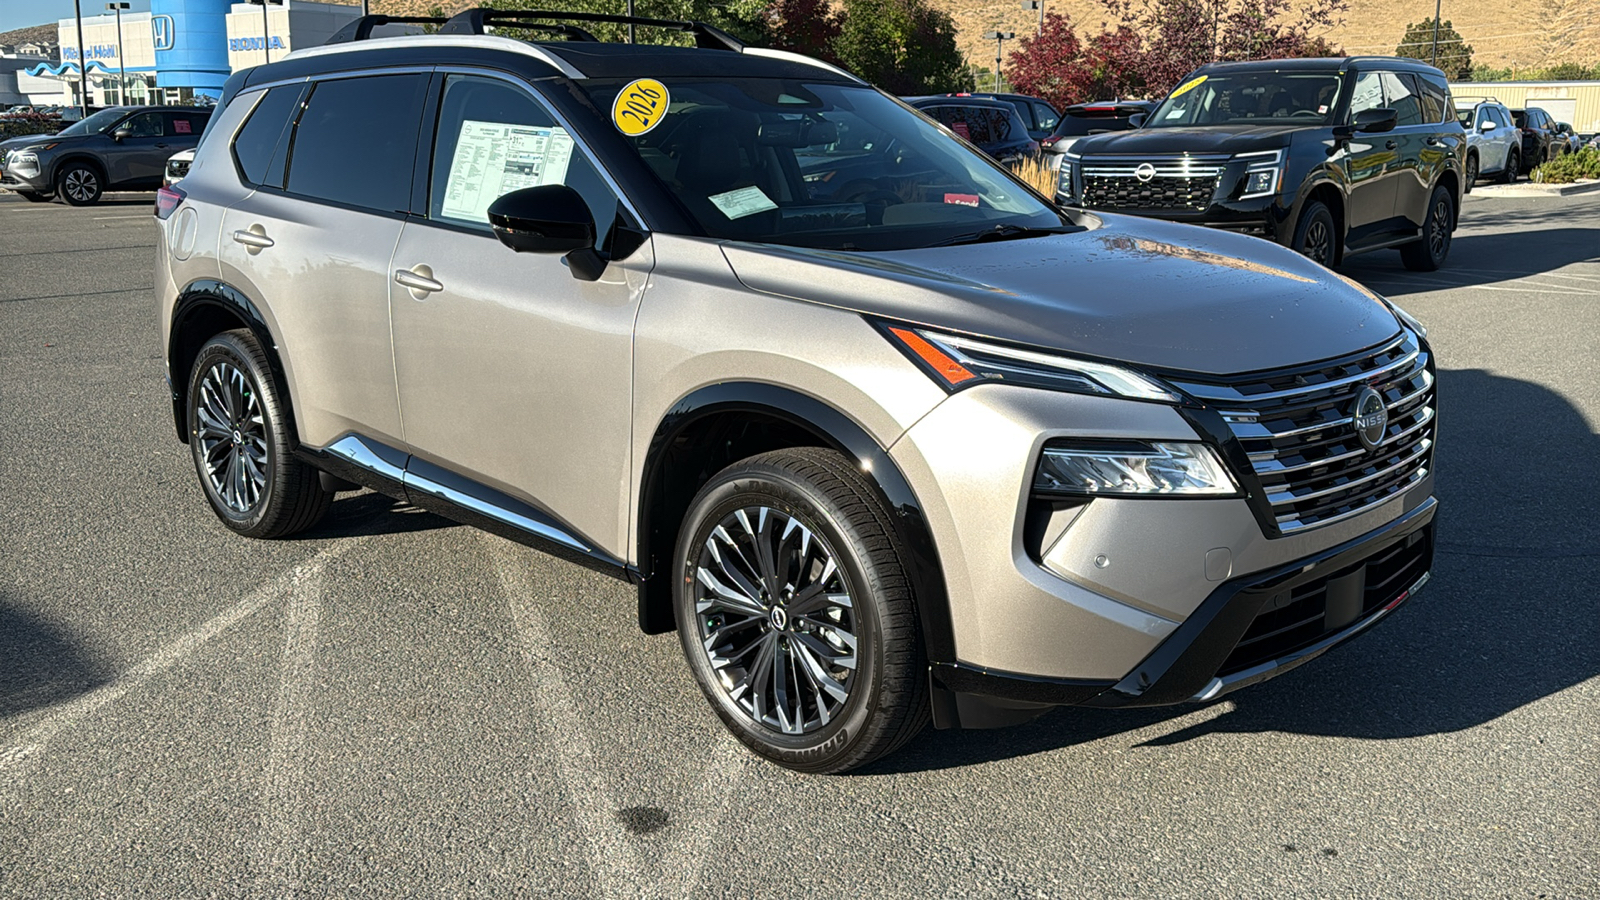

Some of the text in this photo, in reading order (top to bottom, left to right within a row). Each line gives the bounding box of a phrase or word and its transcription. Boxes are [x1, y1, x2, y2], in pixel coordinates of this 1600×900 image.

[229, 36, 283, 51] HONDA
[62, 45, 94, 60] Michel
[621, 83, 661, 127] 2026
[1356, 413, 1386, 428] NISS
